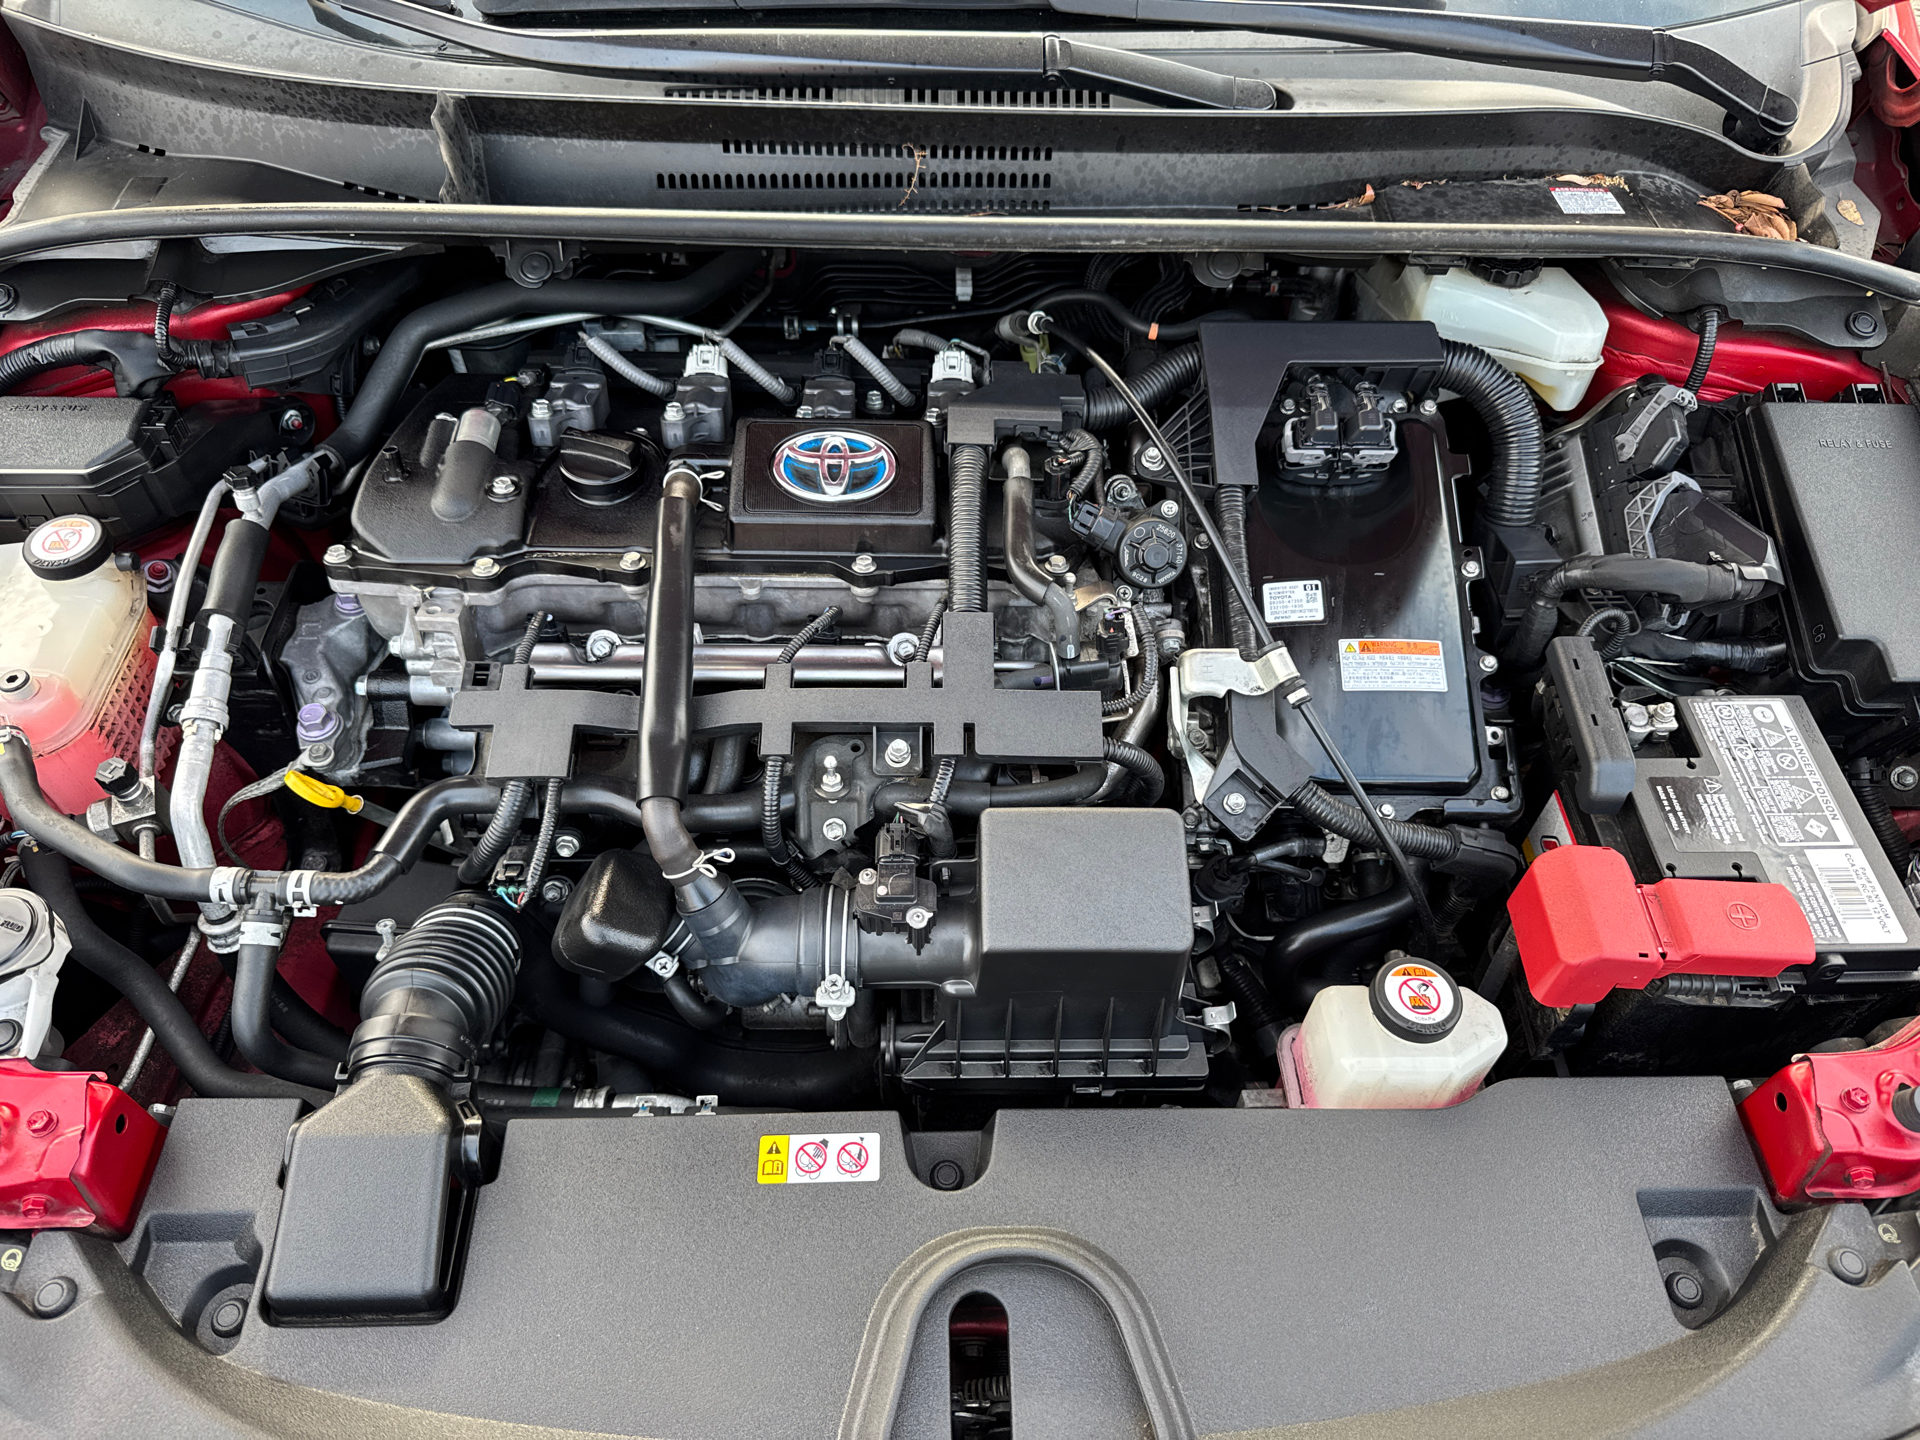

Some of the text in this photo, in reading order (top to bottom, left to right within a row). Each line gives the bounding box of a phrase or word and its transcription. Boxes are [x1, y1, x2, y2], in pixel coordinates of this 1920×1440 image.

[1819, 439, 1892, 449] RELAY & FUSE
[1156, 524, 1176, 539] 25620
[32, 558, 71, 567] DENSO
[1157, 571, 1177, 584] TOYOTA
[1787, 735, 1840, 820] DANGER/POISON
[1655, 785, 1666, 799] MADE
[1666, 812, 1679, 830] KOREA
[1676, 811, 1691, 834] BATTERY
[1785, 866, 1798, 881] SUITE
[1791, 865, 1814, 896] CORPORATE
[1807, 896, 1824, 917] CENTER
[1808, 882, 1832, 916] DISTRIBUTED
[1843, 853, 1856, 867] CCA
[1859, 883, 1869, 893] RC
[1875, 915, 1890, 933] VOLT
[1859, 867, 1890, 918] Part# PLN1AGM
[1407, 1021, 1447, 1033] DENSO
